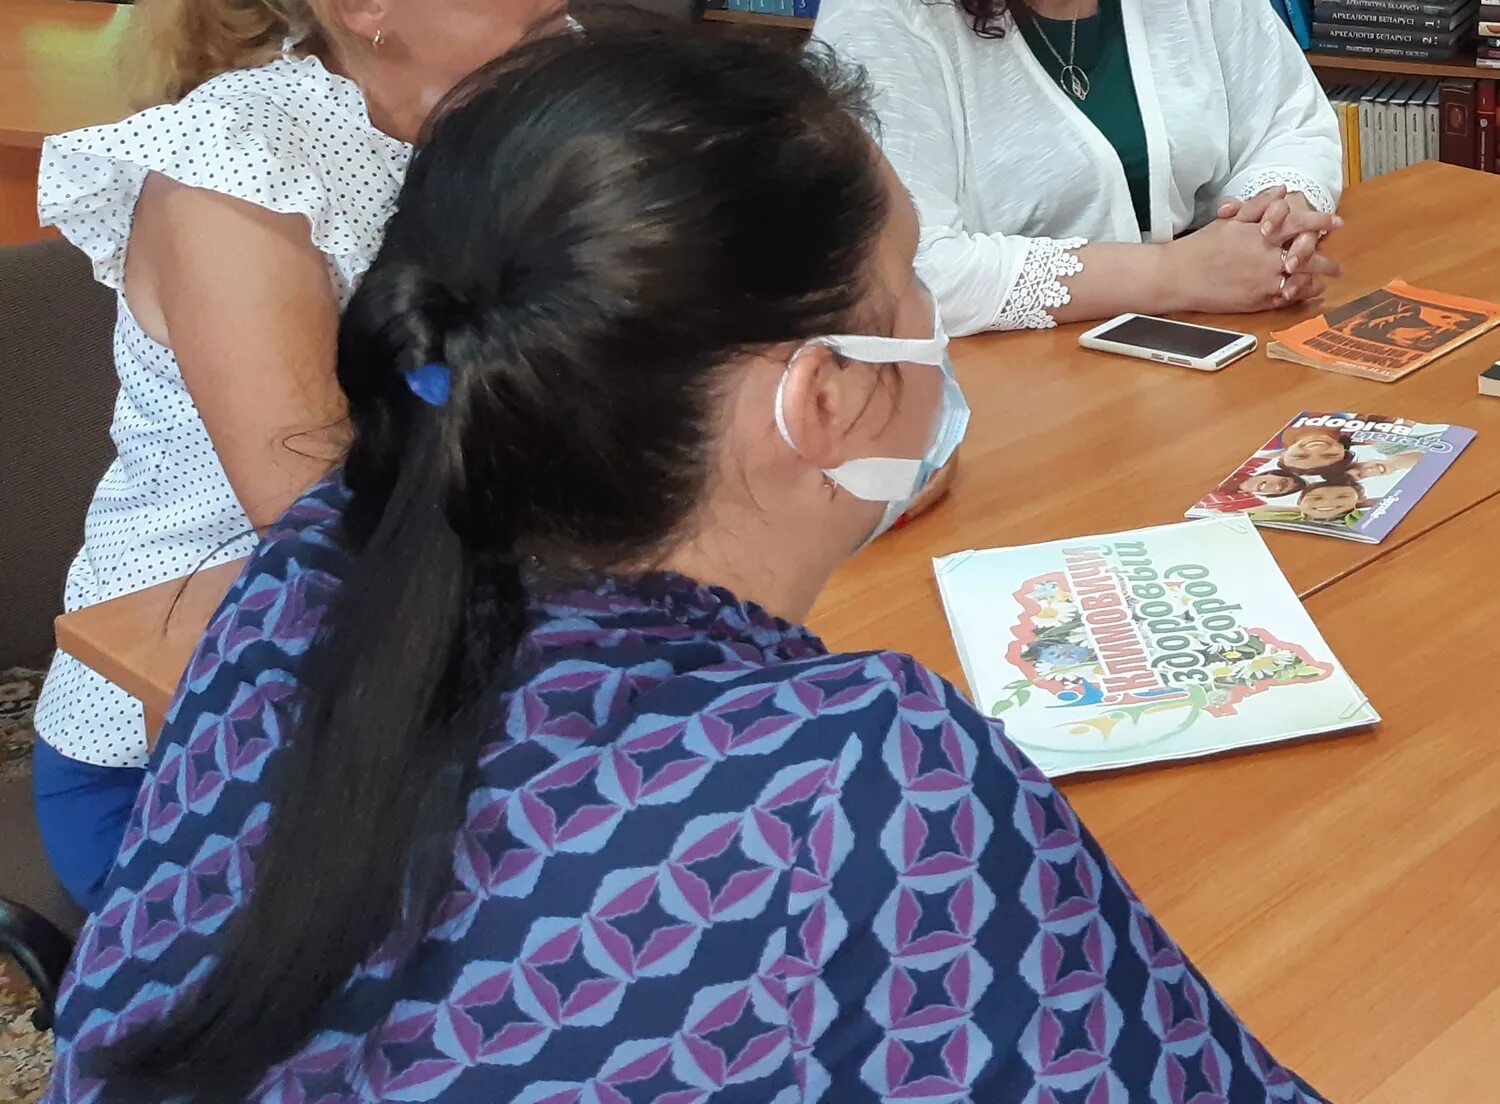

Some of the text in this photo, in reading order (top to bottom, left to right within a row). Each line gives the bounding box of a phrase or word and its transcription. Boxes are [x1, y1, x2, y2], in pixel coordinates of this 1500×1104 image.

[1376, 33, 1412, 42] БЕЛАРУСІ
[1379, 15, 1415, 25] БЕЛАРУСІ
[1062, 546, 1160, 694] КЛИМОВИЧИ
[1102, 541, 1210, 684] здоровый
[1163, 563, 1247, 647] город
